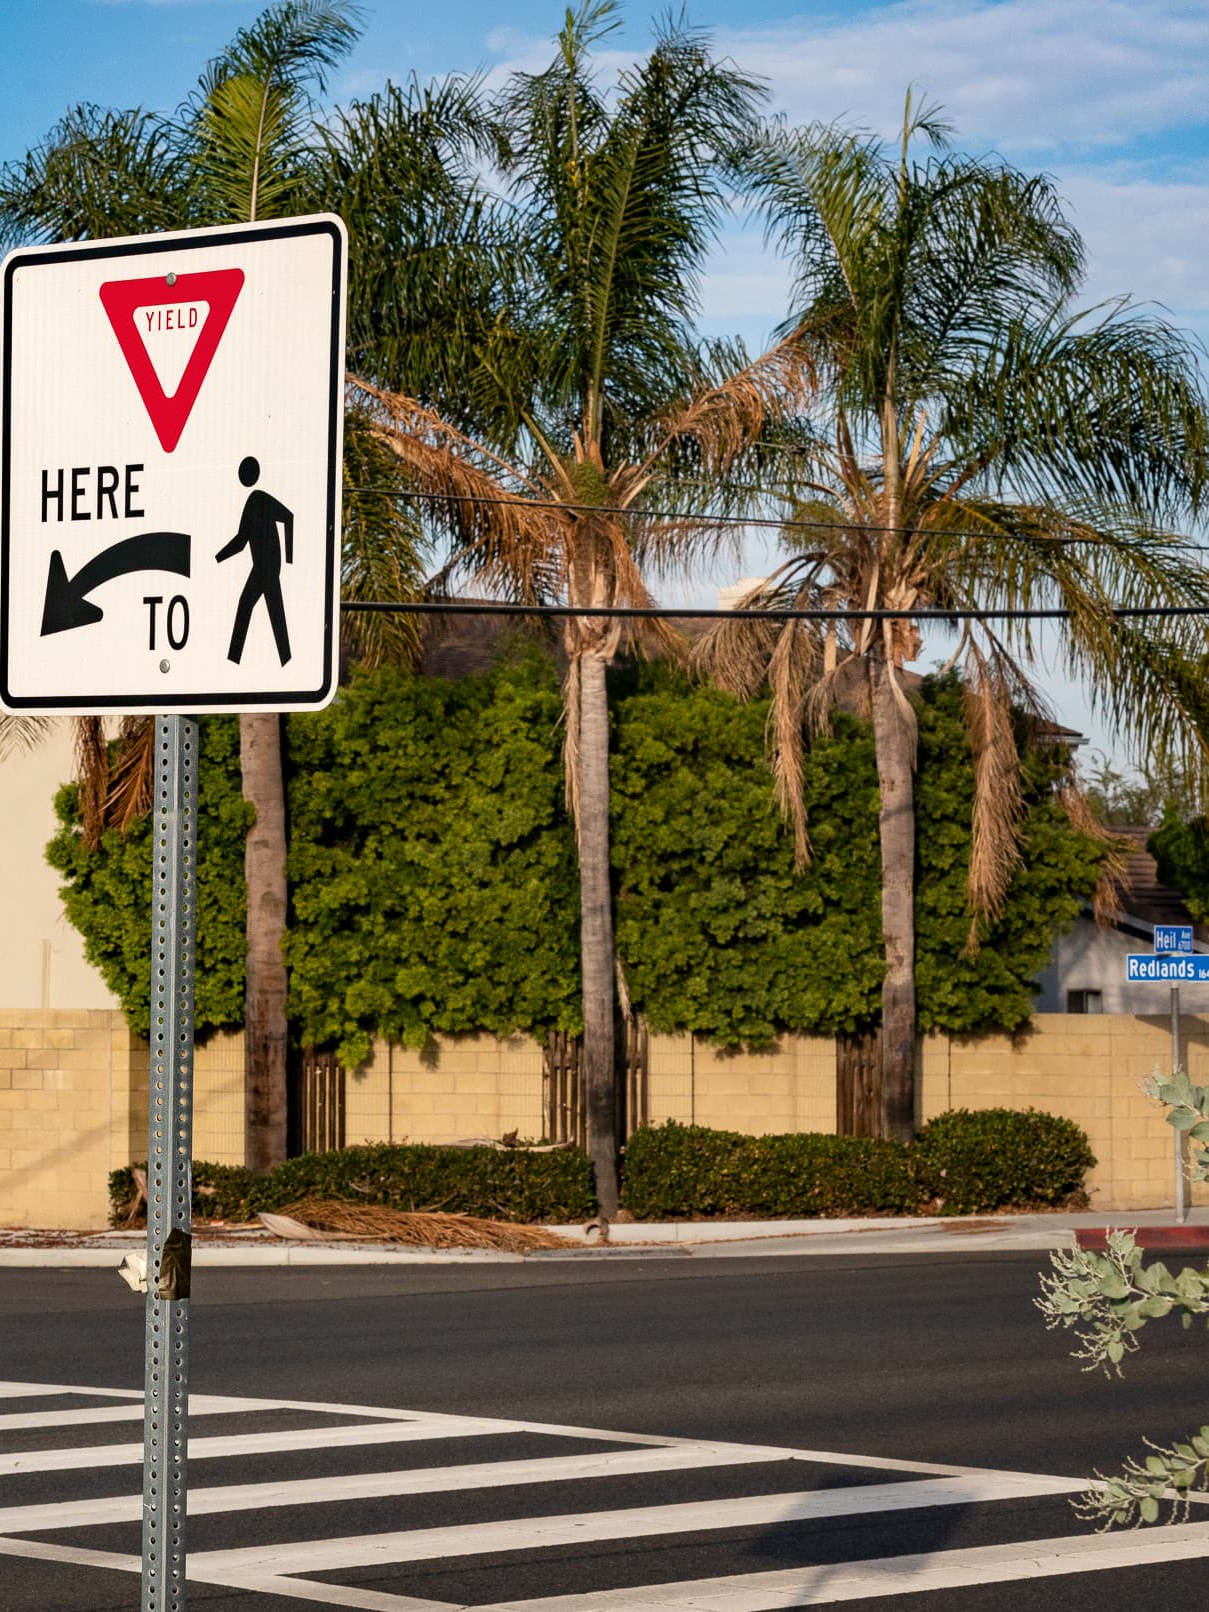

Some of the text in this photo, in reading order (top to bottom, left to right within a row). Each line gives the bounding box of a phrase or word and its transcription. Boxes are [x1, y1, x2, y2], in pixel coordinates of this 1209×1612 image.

[146, 308, 197, 332] YIELD
[41, 463, 145, 522] HERE
[143, 594, 190, 651] TO
[1156, 930, 1176, 949] Heil
[1130, 959, 1194, 977] Redlands
